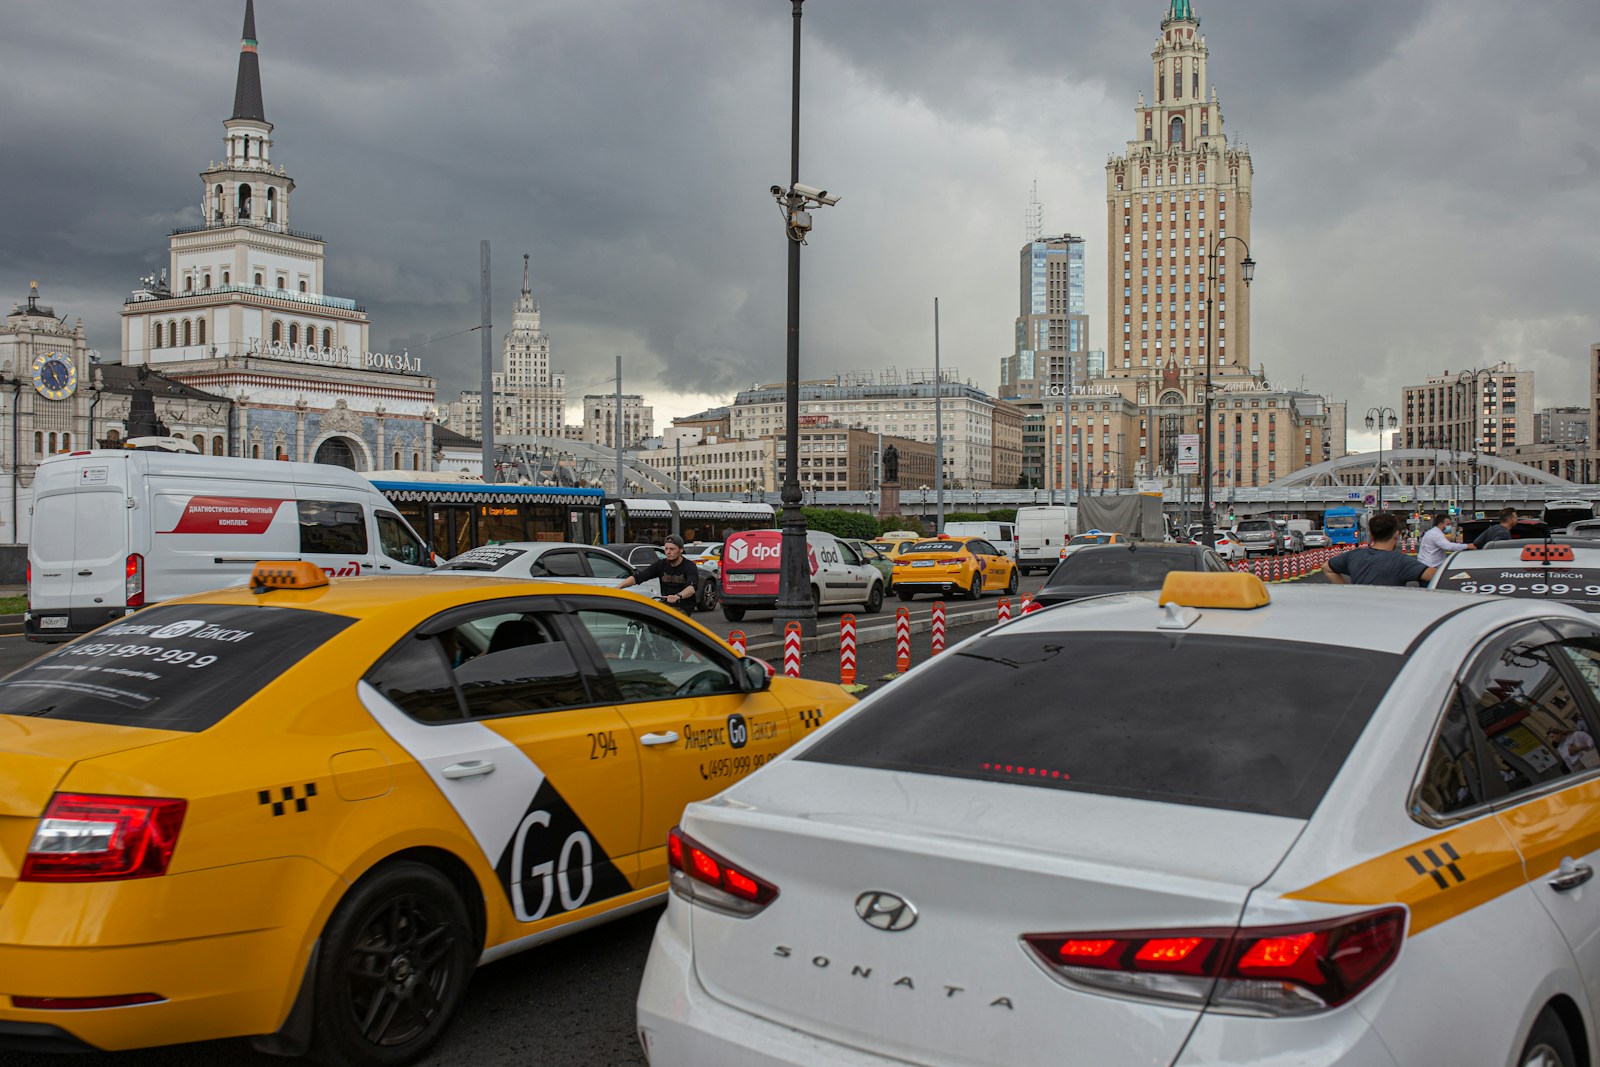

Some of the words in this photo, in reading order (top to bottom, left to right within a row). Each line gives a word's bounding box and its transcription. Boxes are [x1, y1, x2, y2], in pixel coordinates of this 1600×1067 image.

[249, 336, 351, 364] КАЗАНСКИЙ
[363, 350, 421, 372] ВОКЗАЛ
[1045, 384, 1119, 396] ГОСТИНИЦА
[189, 505, 273, 514] ДИАГНОСТИЧЕСКО-РЕМОНТНЫЙ
[752, 542, 781, 561] dpd
[821, 546, 839, 566] dpd
[1500, 571, 1545, 580] Яндекс
[1548, 571, 1583, 579] Такси
[189, 624, 254, 643] Такси
[683, 724, 726, 750] Яндекс
[748, 717, 778, 741] Такси
[587, 730, 618, 760] 294
[708, 758, 733, 780] (495)
[733, 756, 751, 776] 999
[511, 809, 593, 922] Go
[773, 945, 1014, 1011] SONATA
